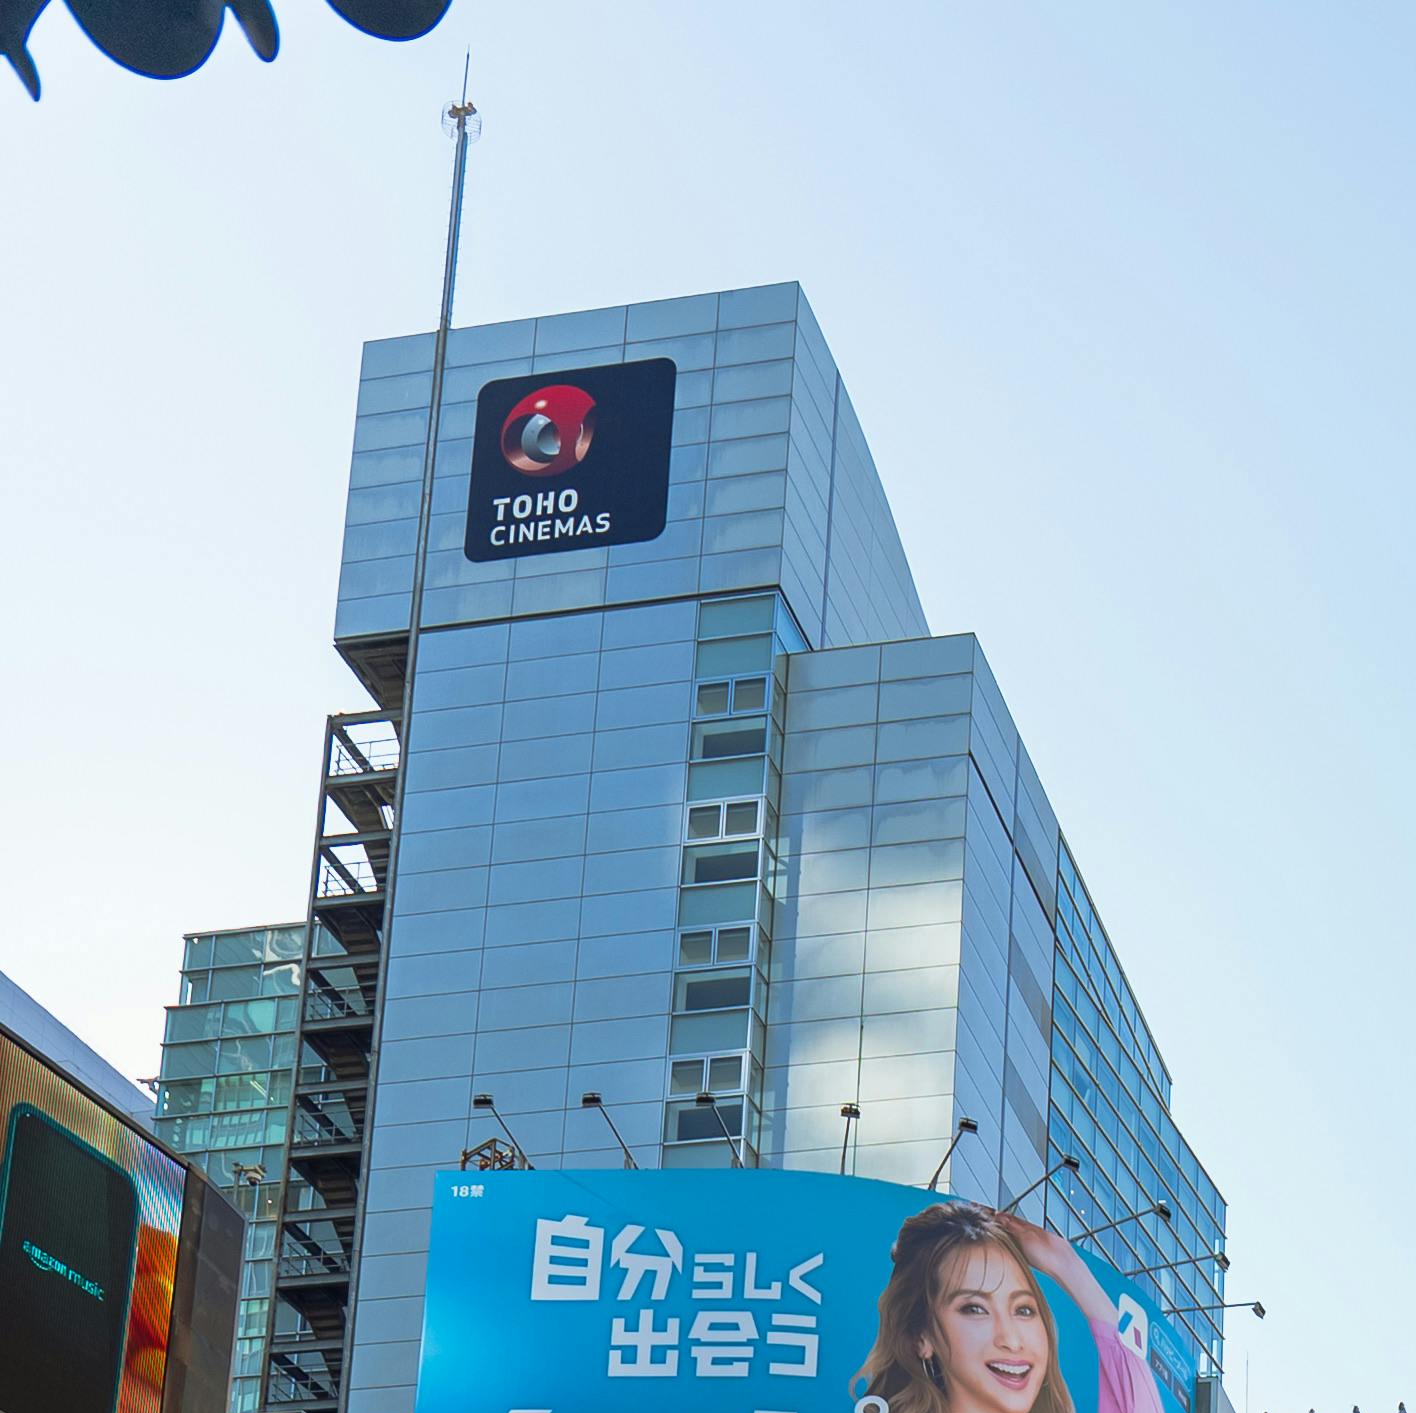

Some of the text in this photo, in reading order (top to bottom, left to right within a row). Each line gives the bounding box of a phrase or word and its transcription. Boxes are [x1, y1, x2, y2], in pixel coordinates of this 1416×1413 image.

[493, 488, 579, 521] TOHO
[490, 512, 611, 547] CINEMAS
[450, 1184, 486, 1199] 18禁
[22, 1240, 105, 1301] amazon music
[530, 1213, 825, 1305] 自分らしく
[606, 1308, 822, 1379] 出会う
